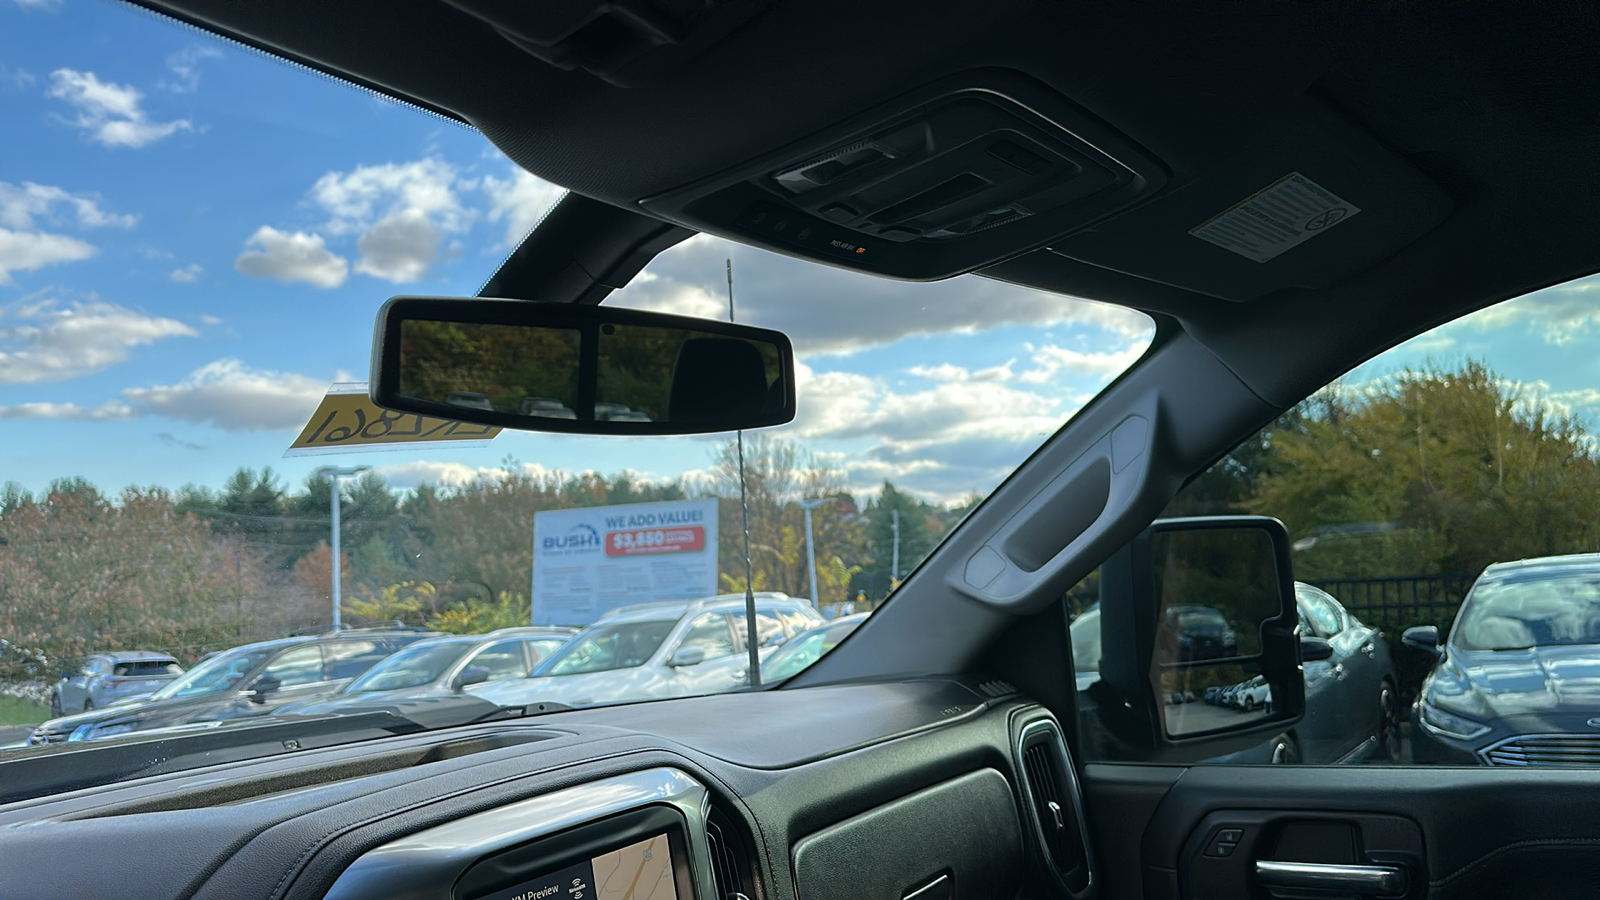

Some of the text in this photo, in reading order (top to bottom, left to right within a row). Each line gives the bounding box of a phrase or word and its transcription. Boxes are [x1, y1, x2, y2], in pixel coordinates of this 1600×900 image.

[605, 509, 703, 529] WE ADD VALUE!
[543, 534, 593, 549] BUSH
[527, 884, 559, 900] Preview
